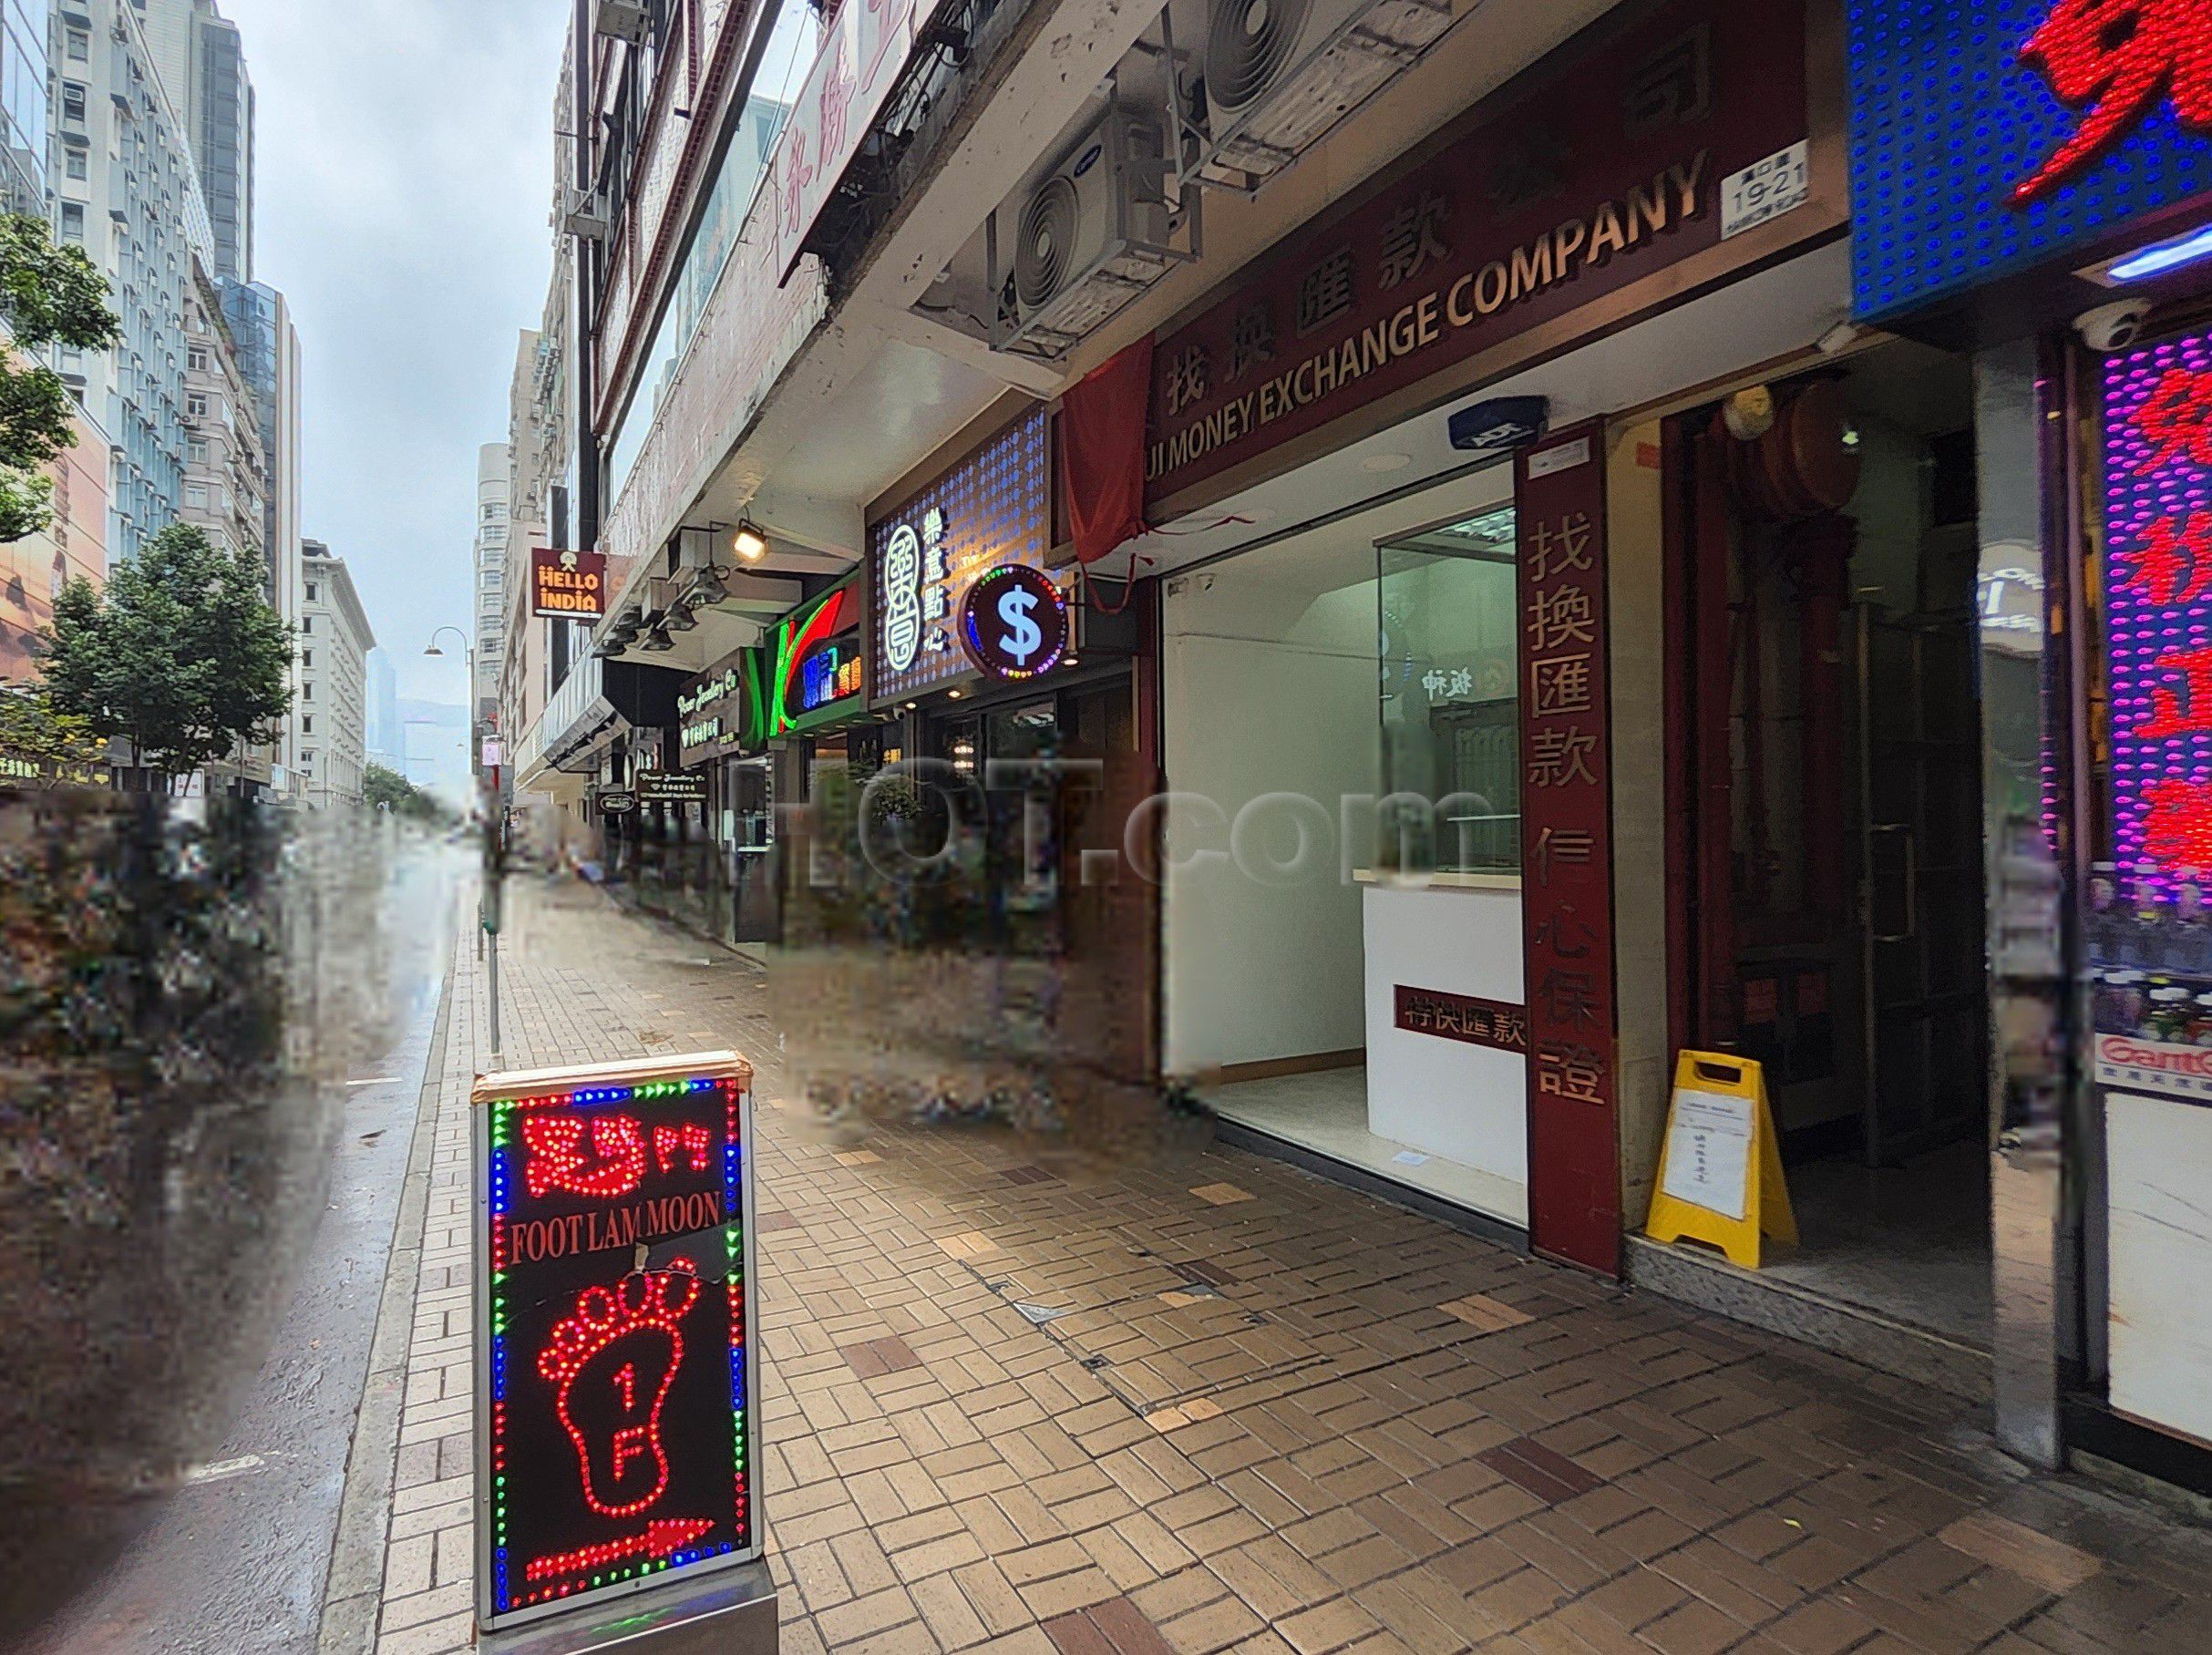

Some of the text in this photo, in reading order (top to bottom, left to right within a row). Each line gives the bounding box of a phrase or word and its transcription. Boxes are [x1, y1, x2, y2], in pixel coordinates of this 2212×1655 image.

[1733, 161, 1805, 213] 19-21
[1168, 391, 1254, 471] MONEY
[1260, 293, 1439, 426] EXCHANGE
[1446, 148, 1710, 326] COMPANY
[539, 565, 599, 591] HELLO
[1528, 512, 1597, 787] 找換匯款
[510, 1190, 721, 1265] FOOT LAM MOON
